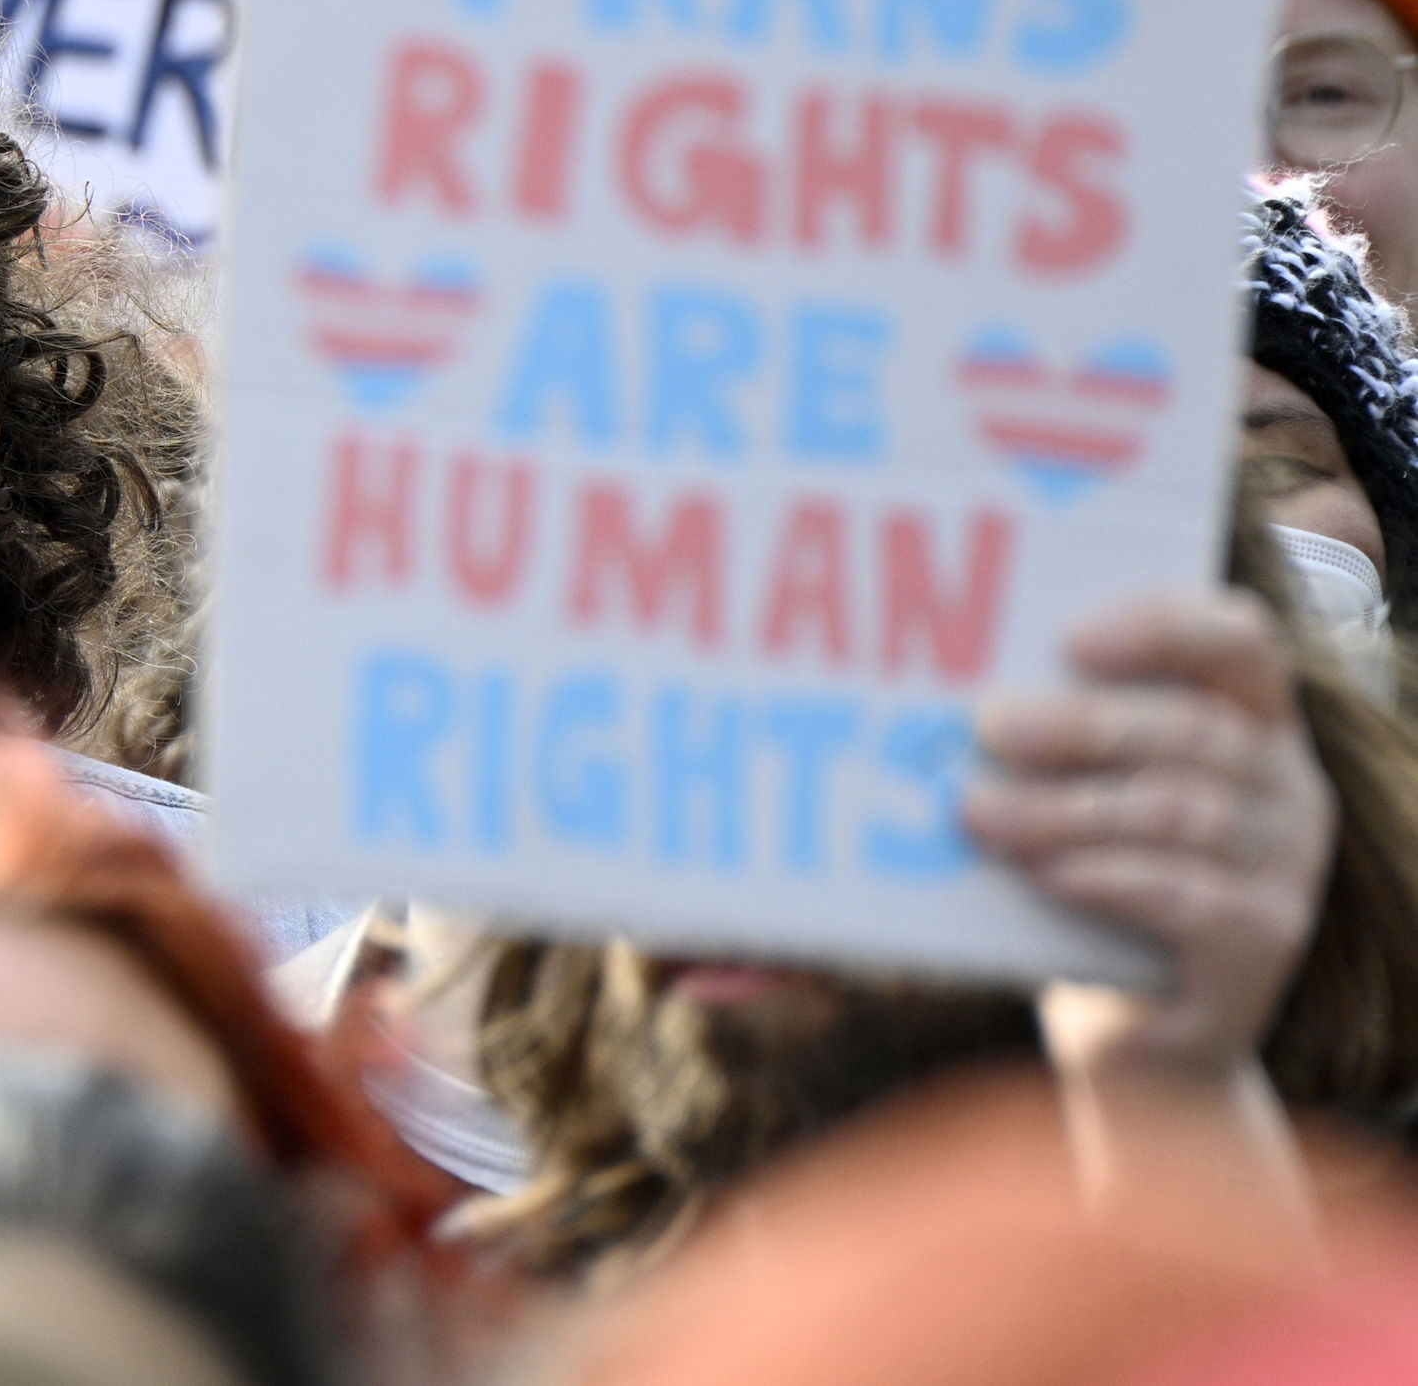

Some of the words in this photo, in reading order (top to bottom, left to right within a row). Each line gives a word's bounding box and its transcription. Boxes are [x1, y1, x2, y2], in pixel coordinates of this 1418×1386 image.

[371, 36, 1133, 282] RIGHTS
[486, 279, 896, 466] ARE
[316, 430, 1024, 688] HUMAN
[346, 646, 982, 887] RIGHTS
